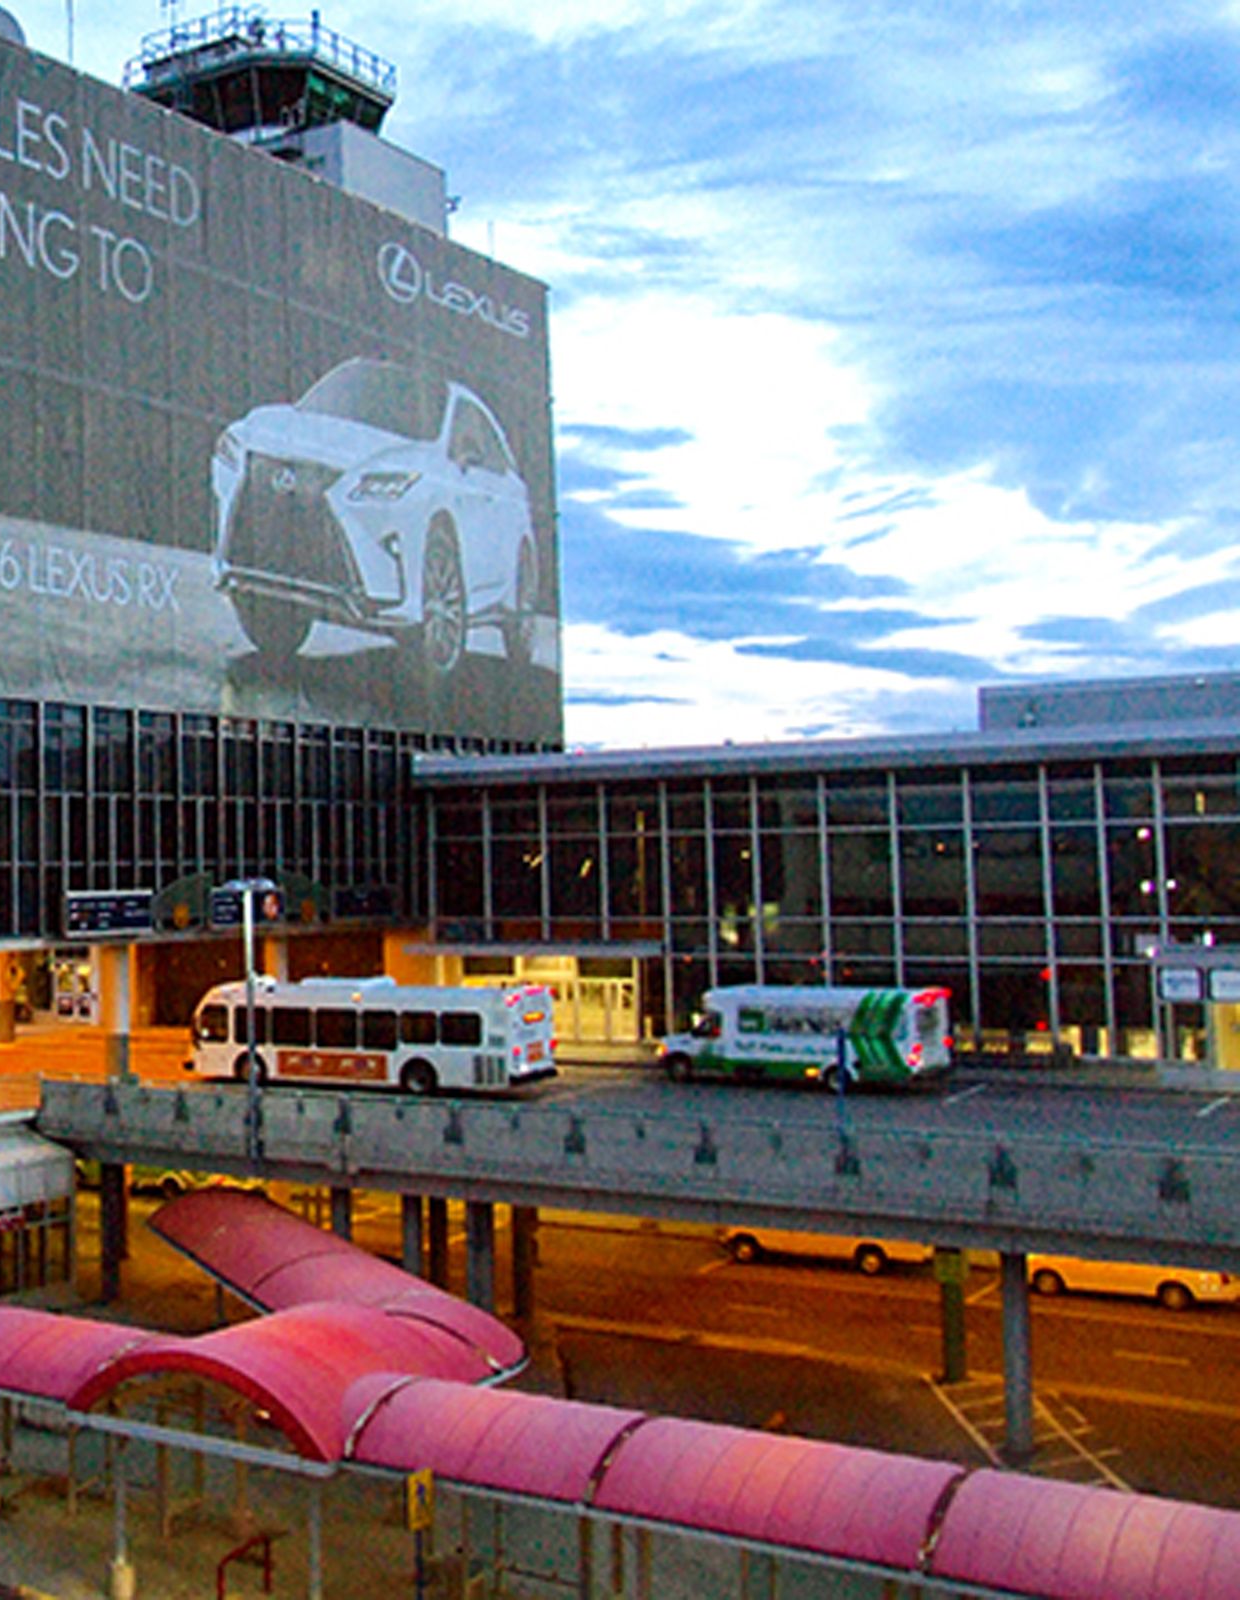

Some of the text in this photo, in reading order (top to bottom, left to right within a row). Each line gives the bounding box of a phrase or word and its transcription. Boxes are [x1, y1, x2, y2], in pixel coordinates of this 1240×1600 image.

[82, 127, 202, 227] NEED
[91, 225, 154, 302] TO
[424, 270, 530, 340] LEXUS
[28, 543, 132, 607] LEXUS
[137, 562, 182, 613] RX
